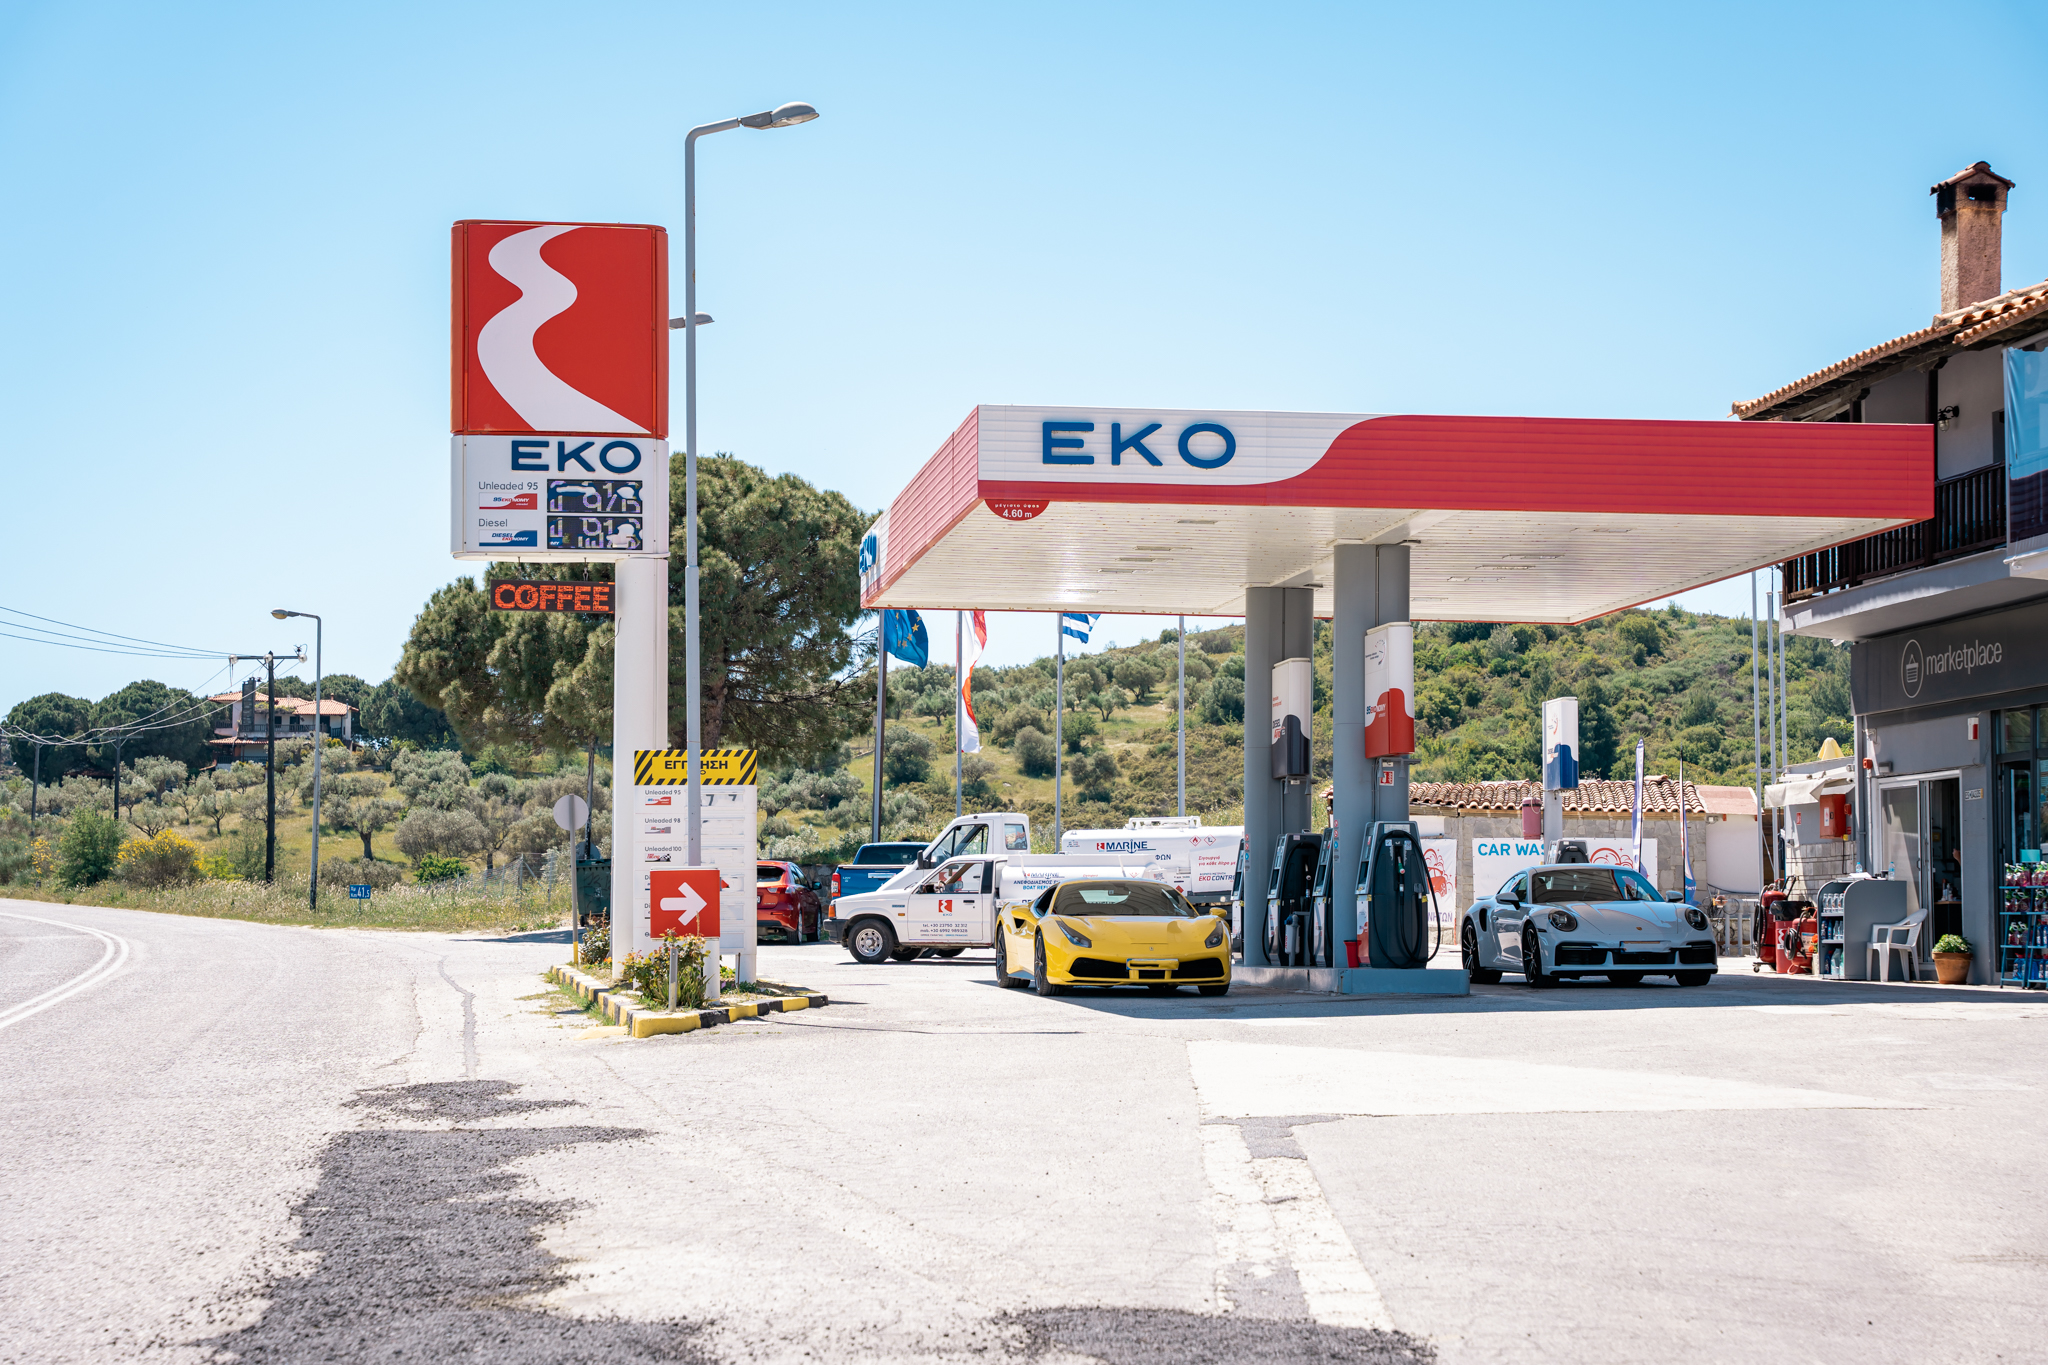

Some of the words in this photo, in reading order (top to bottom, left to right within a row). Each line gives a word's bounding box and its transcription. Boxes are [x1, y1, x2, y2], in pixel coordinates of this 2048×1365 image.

[1042, 421, 1236, 469] EKO
[511, 440, 642, 475] EKO
[478, 481, 524, 491] Unleaded
[526, 481, 539, 491] 95
[1002, 509, 1023, 518] 4.60
[478, 518, 508, 527] Diesel
[859, 535, 877, 573] EKO
[494, 583, 610, 611] COFFEE
[1926, 639, 2003, 675] marketplace
[664, 760, 728, 770] ΕΓΓΗΣΗ
[1106, 839, 1148, 853] MARINE
[1478, 843, 1511, 856] CAR
[1428, 911, 1453, 922] ΝΗΤΩΝ
